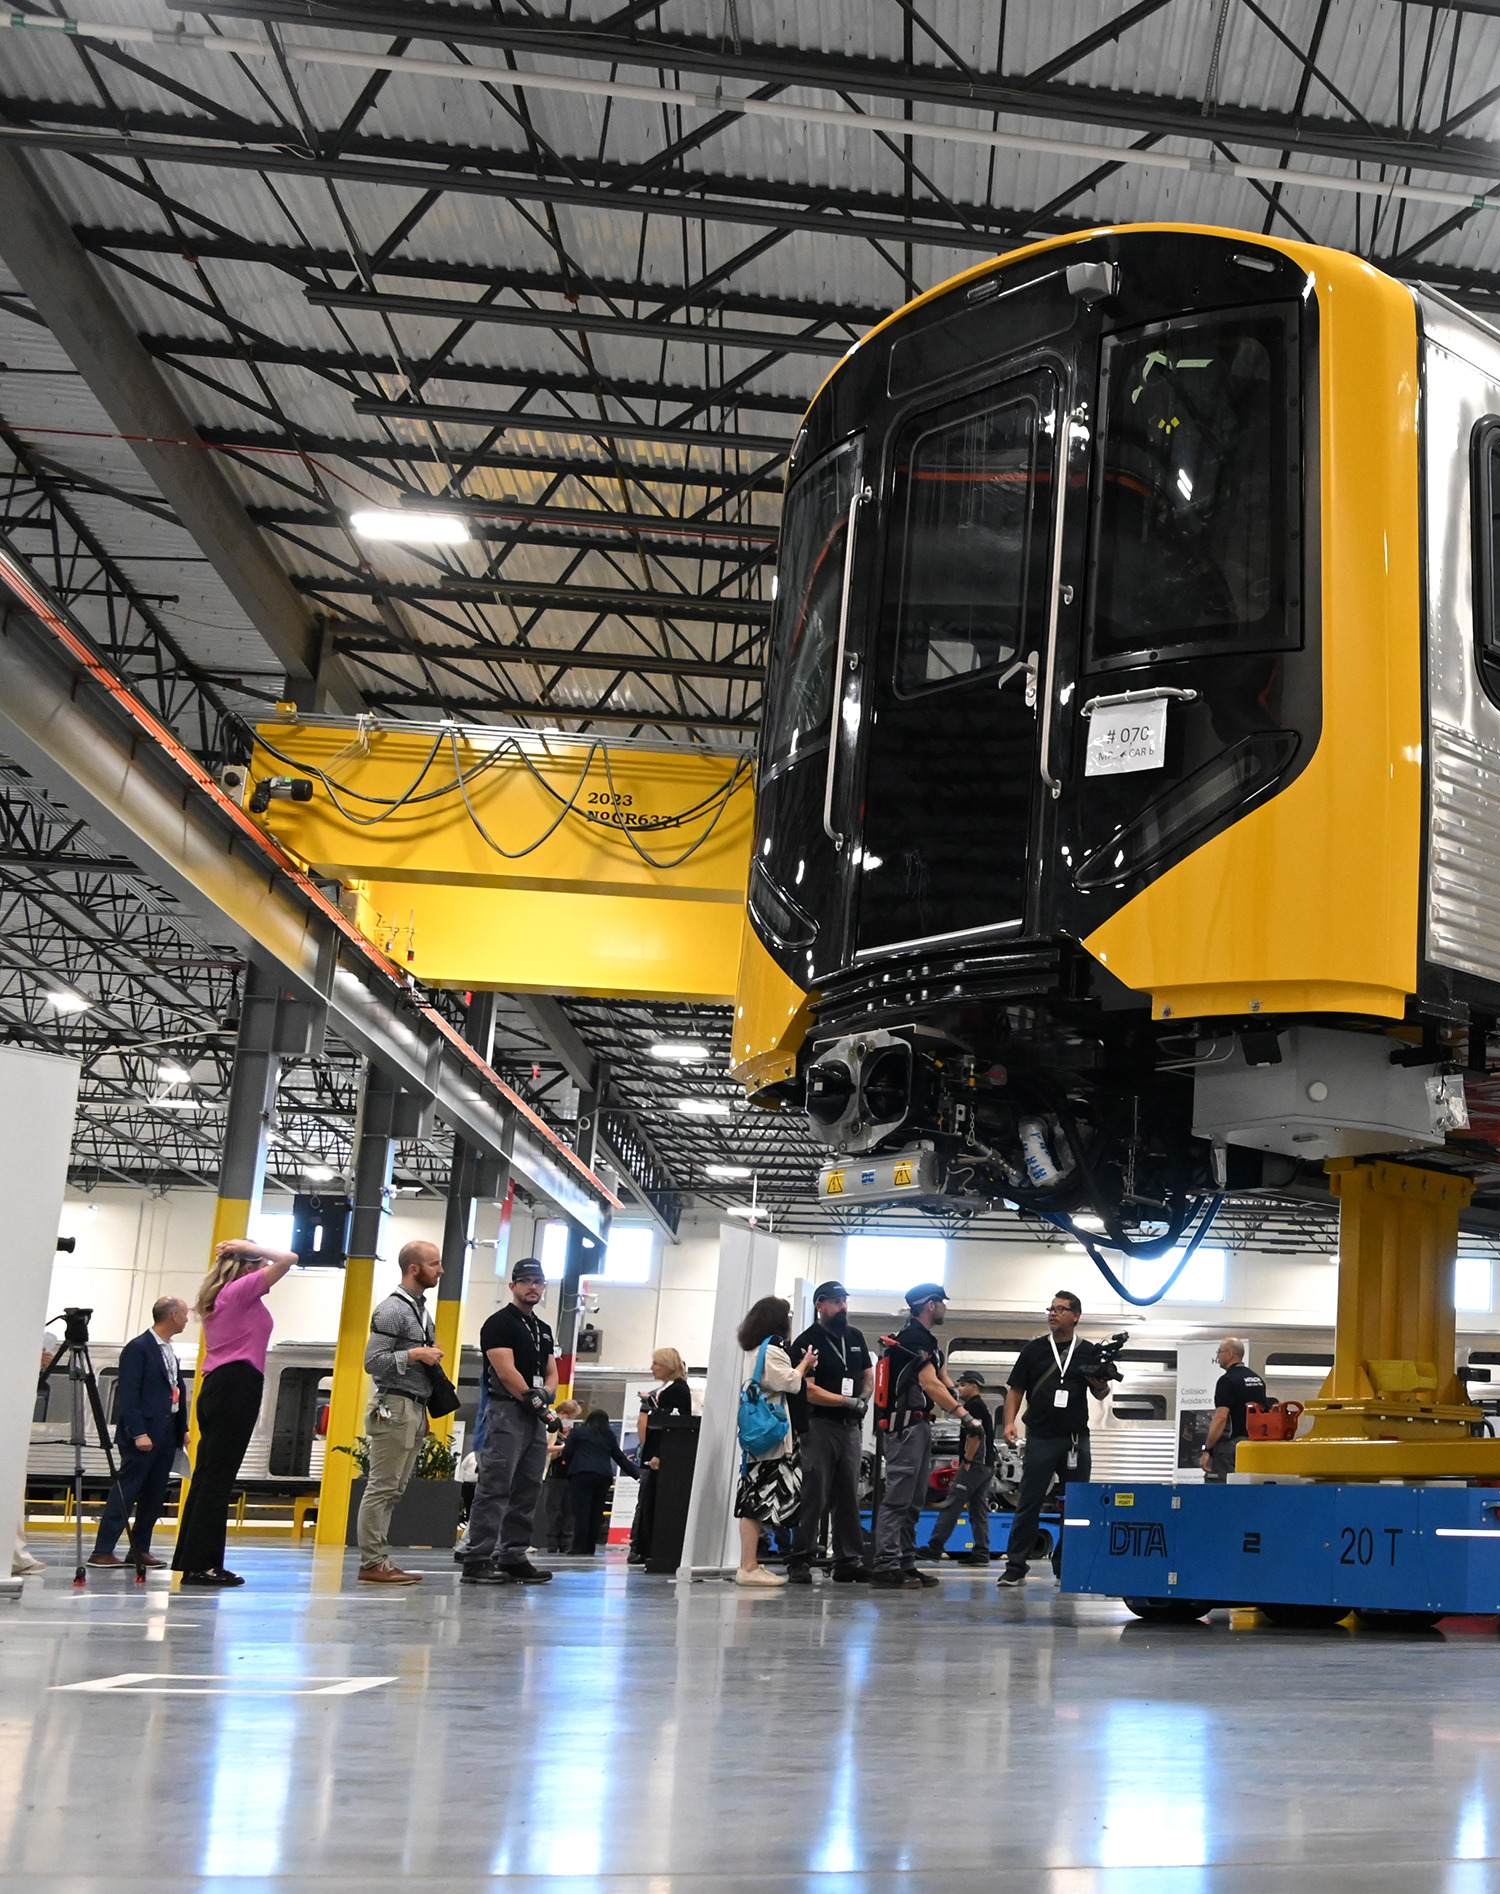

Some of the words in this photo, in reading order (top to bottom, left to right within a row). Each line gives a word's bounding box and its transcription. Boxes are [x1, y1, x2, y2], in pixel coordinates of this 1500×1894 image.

[1128, 747, 1147, 757] CAR
[587, 792, 633, 806] 2023
[1180, 1387, 1208, 1396] Collision
[1180, 1397, 1213, 1405] Avoidance
[1261, 1423, 1269, 1436] 2
[1110, 1521, 1168, 1558] DTA
[1340, 1527, 1373, 1566] 20
[1384, 1528, 1403, 1566] T
